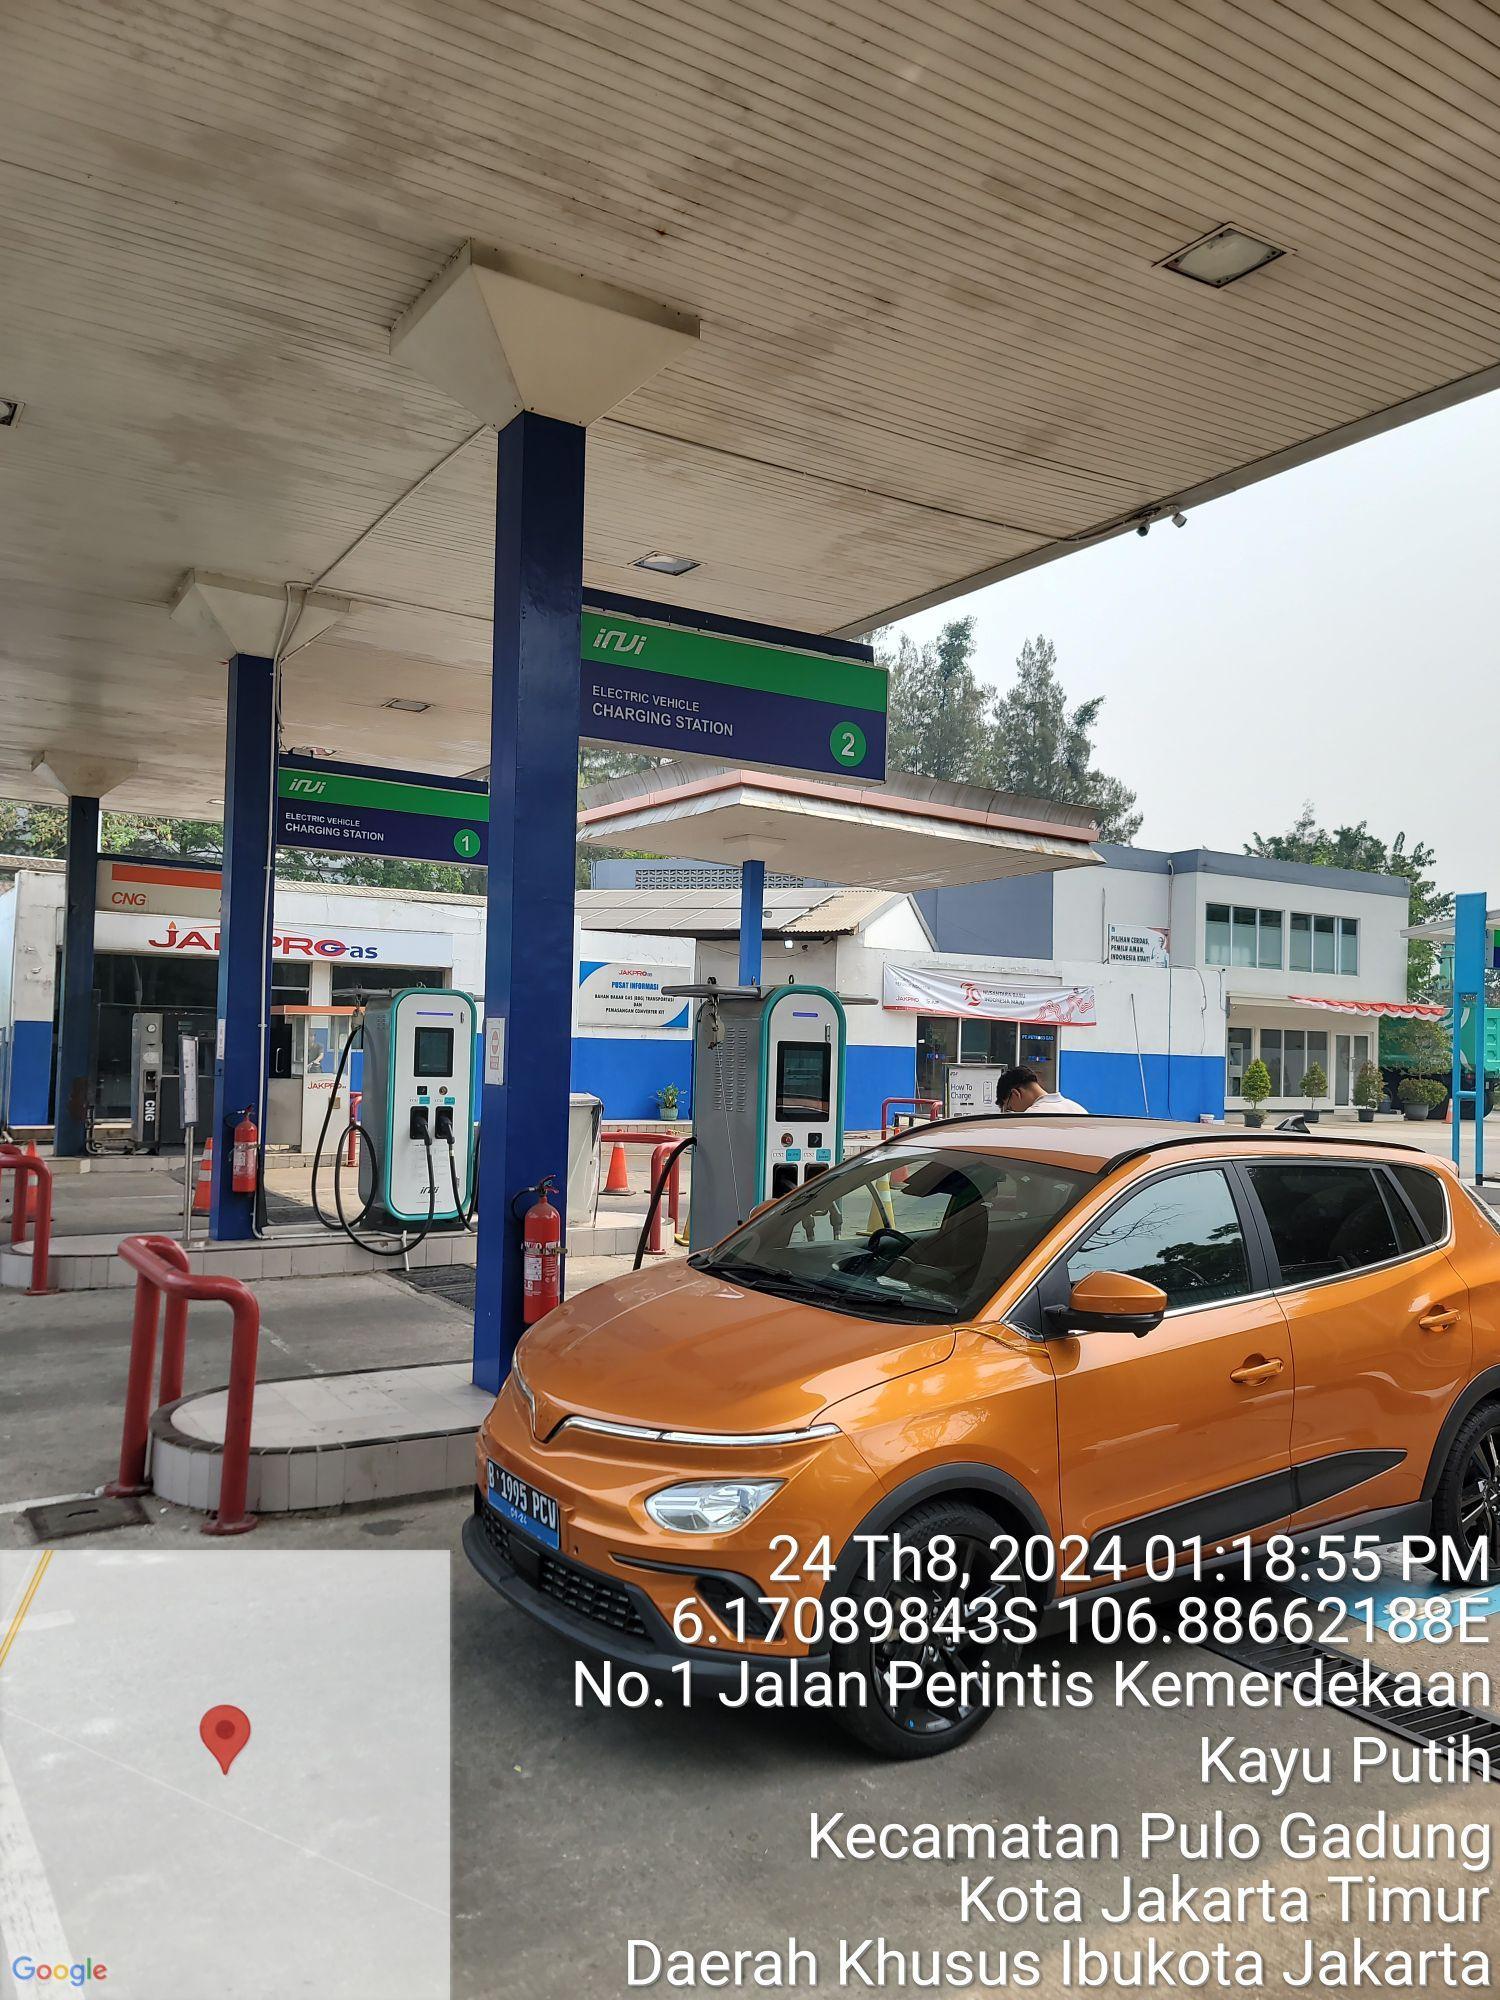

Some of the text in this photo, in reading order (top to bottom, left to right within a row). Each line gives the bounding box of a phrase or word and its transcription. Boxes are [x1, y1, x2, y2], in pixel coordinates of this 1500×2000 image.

[592, 685, 700, 712] ELECTRIC VEHICLE
[592, 702, 733, 736] CHARGING STATION
[841, 732, 855, 757] 2
[285, 812, 361, 827] ELECTRIC VEHICLE
[285, 822, 384, 841] CHARGING STATION
[461, 836, 469, 851] 1
[112, 892, 147, 906] CNG
[1131, 937, 1150, 946] CERDAS,
[618, 969, 647, 977] JAKPRO
[611, 981, 659, 991] PUSAT INFORMASI
[951, 1083, 964, 1091] How
[951, 1091, 971, 1100] Charge
[145, 1100, 155, 1122] CNG
[488, 1461, 495, 1488] B
[501, 1472, 527, 1511] 1995
